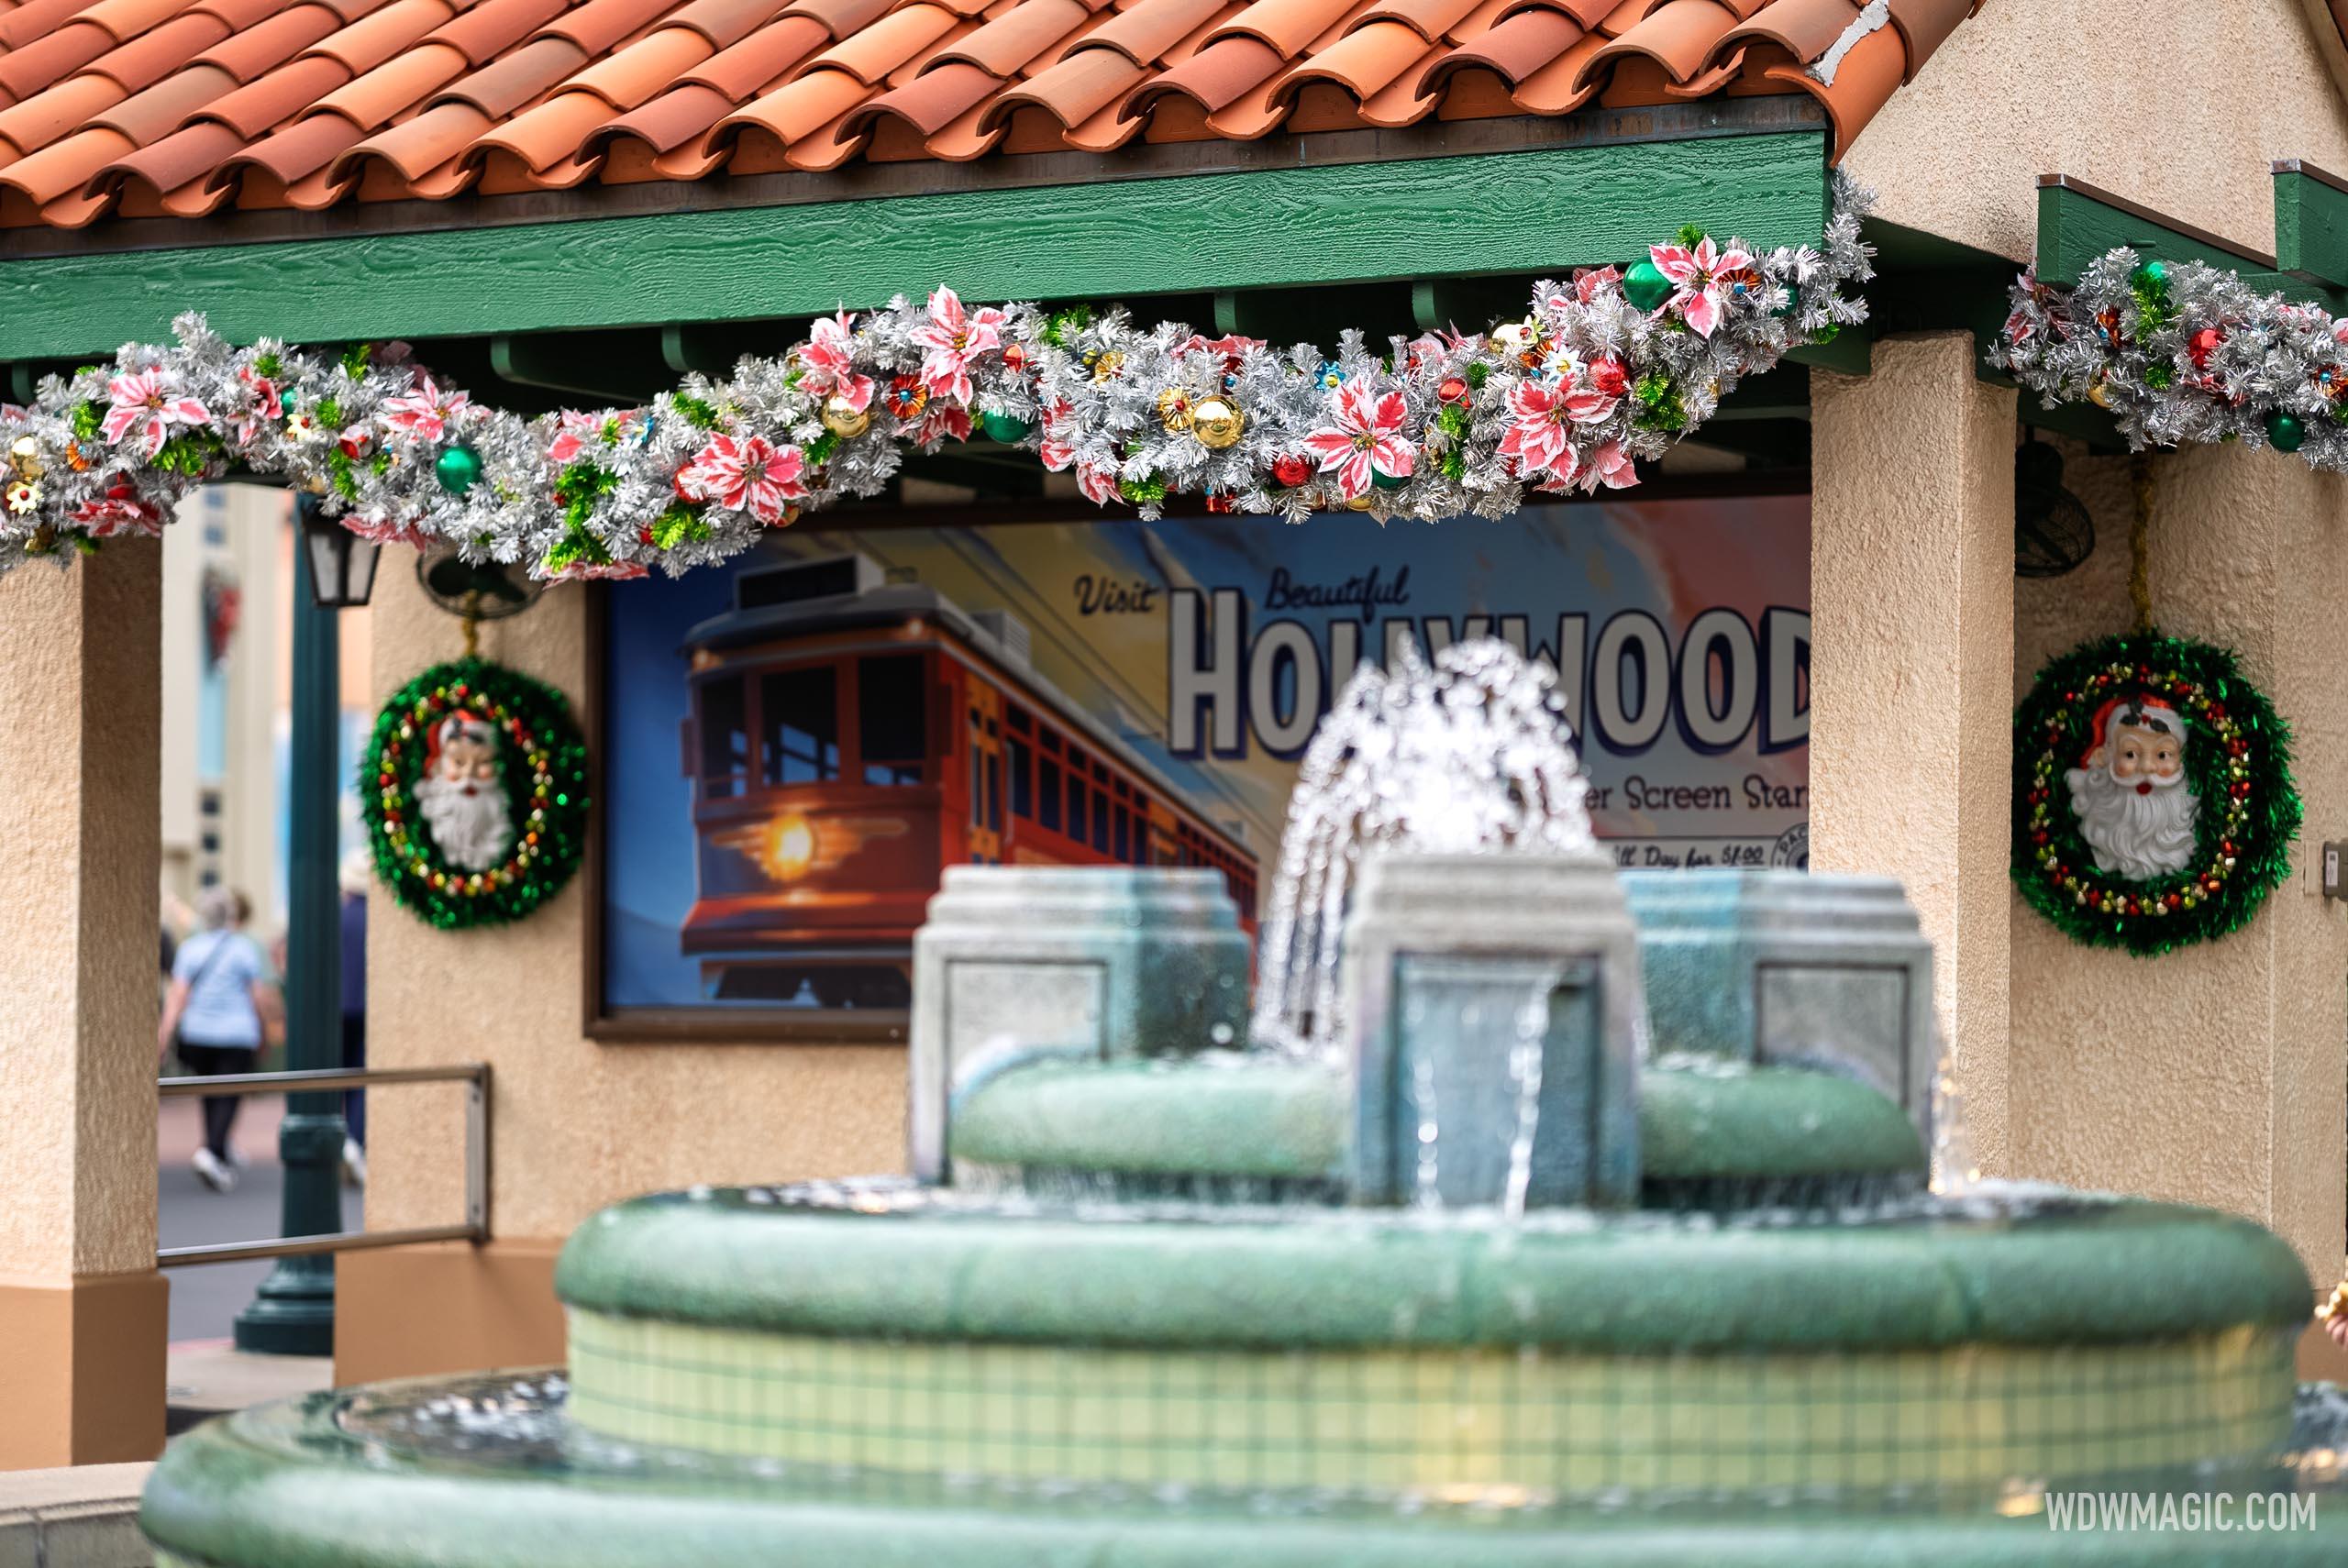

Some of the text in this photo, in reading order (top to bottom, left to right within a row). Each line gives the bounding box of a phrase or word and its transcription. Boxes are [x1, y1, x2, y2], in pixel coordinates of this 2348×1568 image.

[1074, 564, 1411, 624] Visit Beautiful
[1623, 774, 1731, 811] Screen
[1743, 774, 1810, 810] Star
[1644, 845, 1680, 867] Day
[1685, 847, 1714, 867] for
